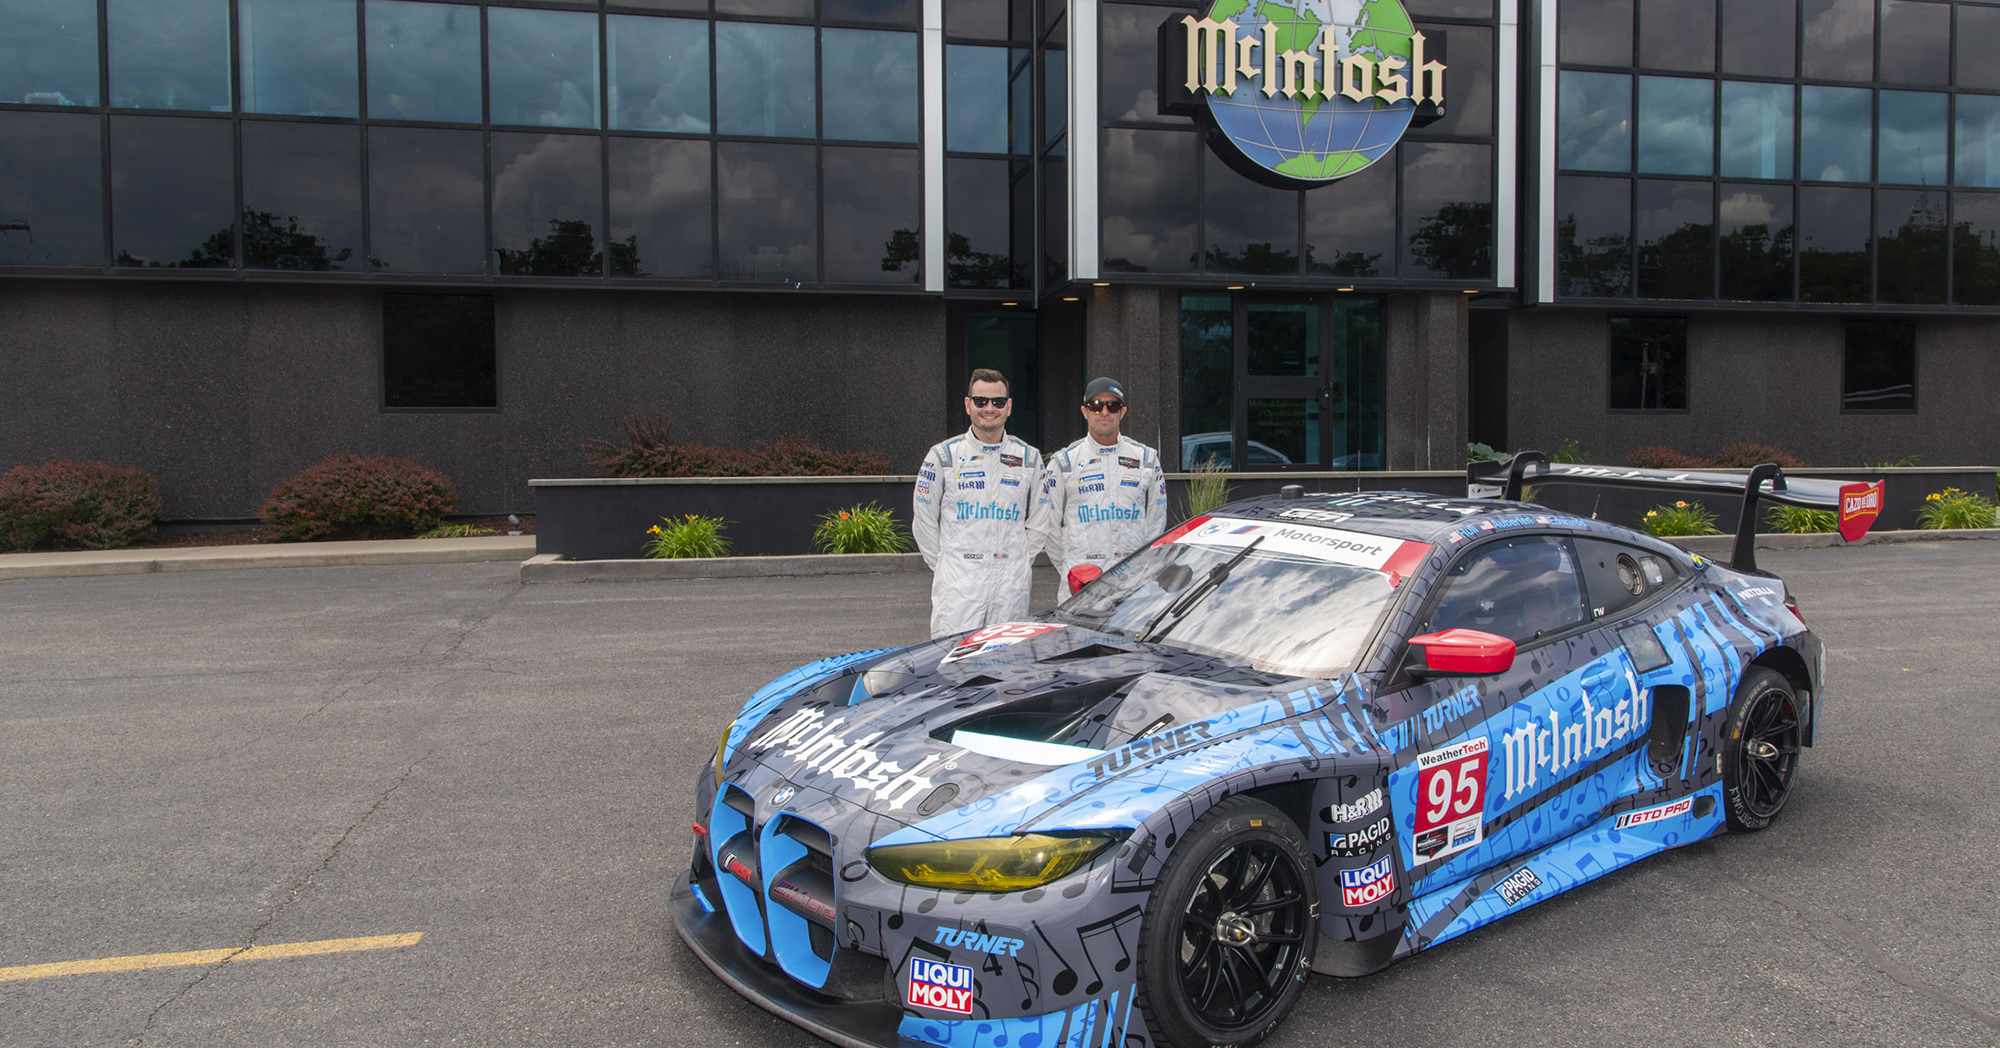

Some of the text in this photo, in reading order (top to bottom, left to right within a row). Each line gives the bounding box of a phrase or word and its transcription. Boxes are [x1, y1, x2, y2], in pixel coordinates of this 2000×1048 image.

[1180, 14, 1447, 106] McIntosh
[956, 501, 1021, 521] McIntosh
[1078, 501, 1140, 523] McIntosh
[1491, 516, 1534, 530] Auberlen
[1546, 516, 1587, 528] Edwards
[1273, 528, 1383, 557] Motorsport
[1456, 523, 1479, 539] Hull
[973, 625, 1048, 641] 95
[1423, 684, 1482, 735] TURNER
[1502, 667, 1649, 800] McIntosh
[748, 707, 941, 811] McIntosh
[1087, 721, 1213, 781] TURNER
[1420, 741, 1486, 766] WeatherTech
[1427, 758, 1480, 823] 95
[1631, 800, 1691, 824] GTD PRO
[1331, 833, 1391, 857] RACING
[1348, 817, 1390, 848] PAGID
[1342, 859, 1391, 887] LIQUI
[1503, 869, 1535, 895] PAGID
[1346, 876, 1394, 904] MOLY
[1506, 878, 1541, 905] RACING
[933, 926, 1025, 957] TURNER
[913, 958, 970, 987] LIQUI
[911, 982, 971, 1011] MOLY
